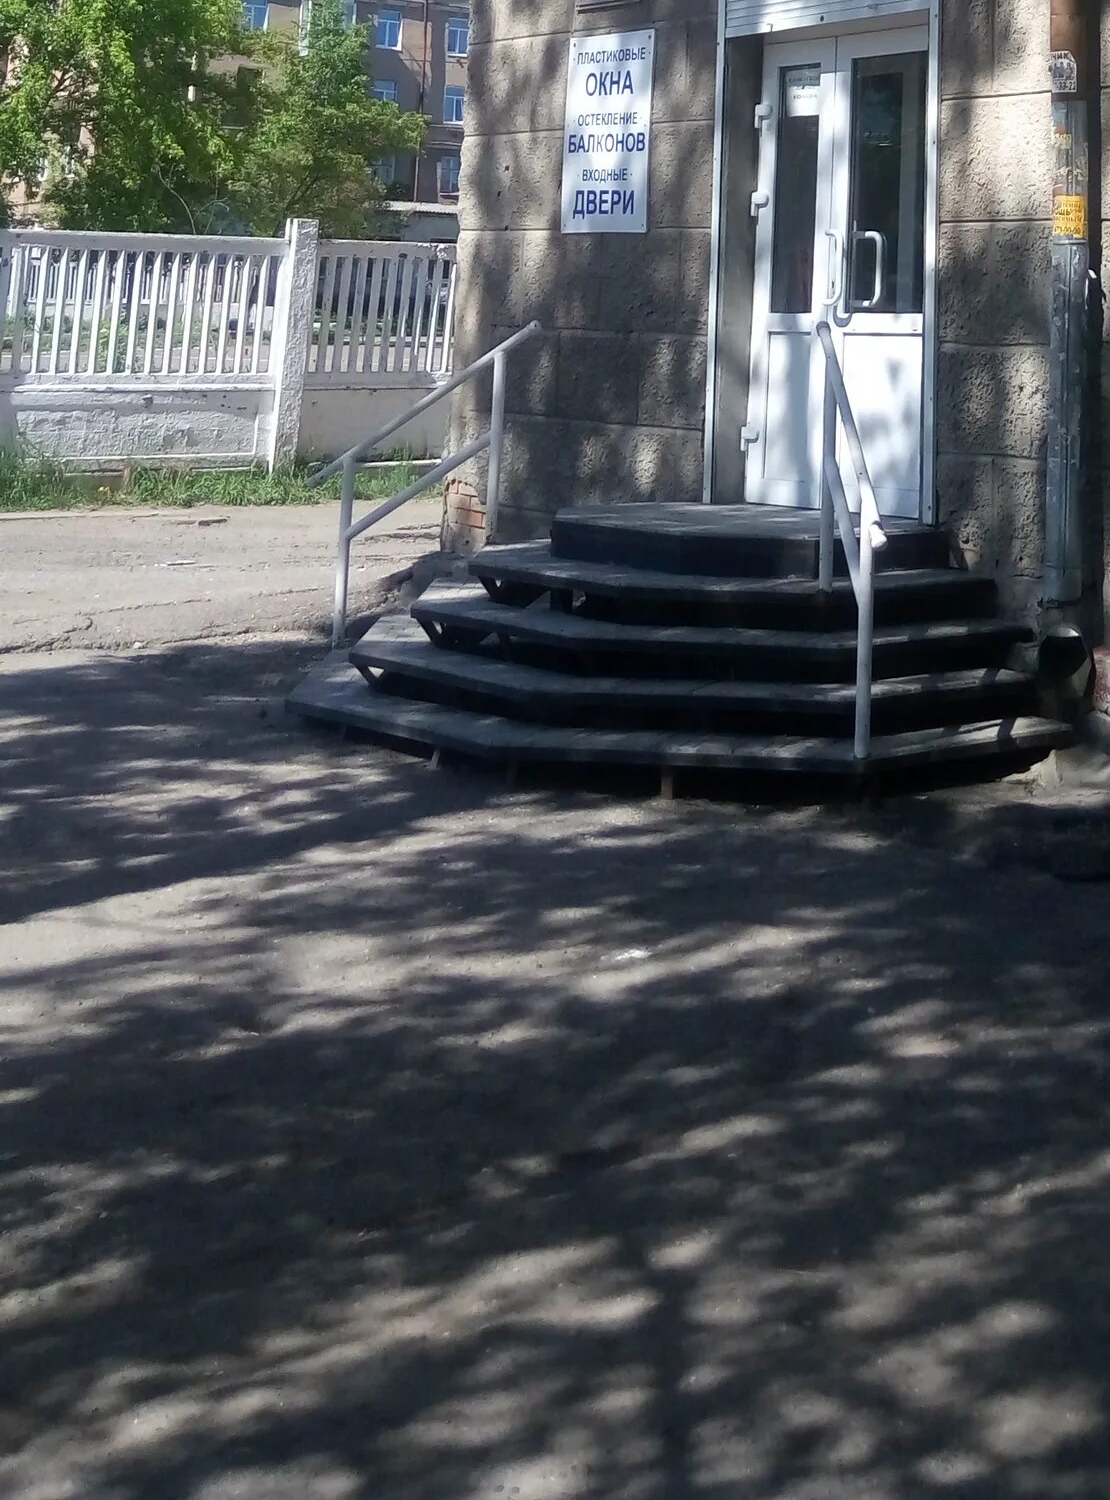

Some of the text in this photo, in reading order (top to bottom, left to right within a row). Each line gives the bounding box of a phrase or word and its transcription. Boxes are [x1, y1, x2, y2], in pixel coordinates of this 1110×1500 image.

[577, 47, 646, 65] ПЛАСТИКОВЫЕ
[585, 70, 634, 96] ОКНА
[577, 112, 638, 127] ОСТЕКЛЕНИЕ
[568, 132, 646, 153] БАЛКОНОВ
[582, 168, 628, 184] ВХОДНЫЕ
[572, 190, 635, 220] ДВЕРИ
